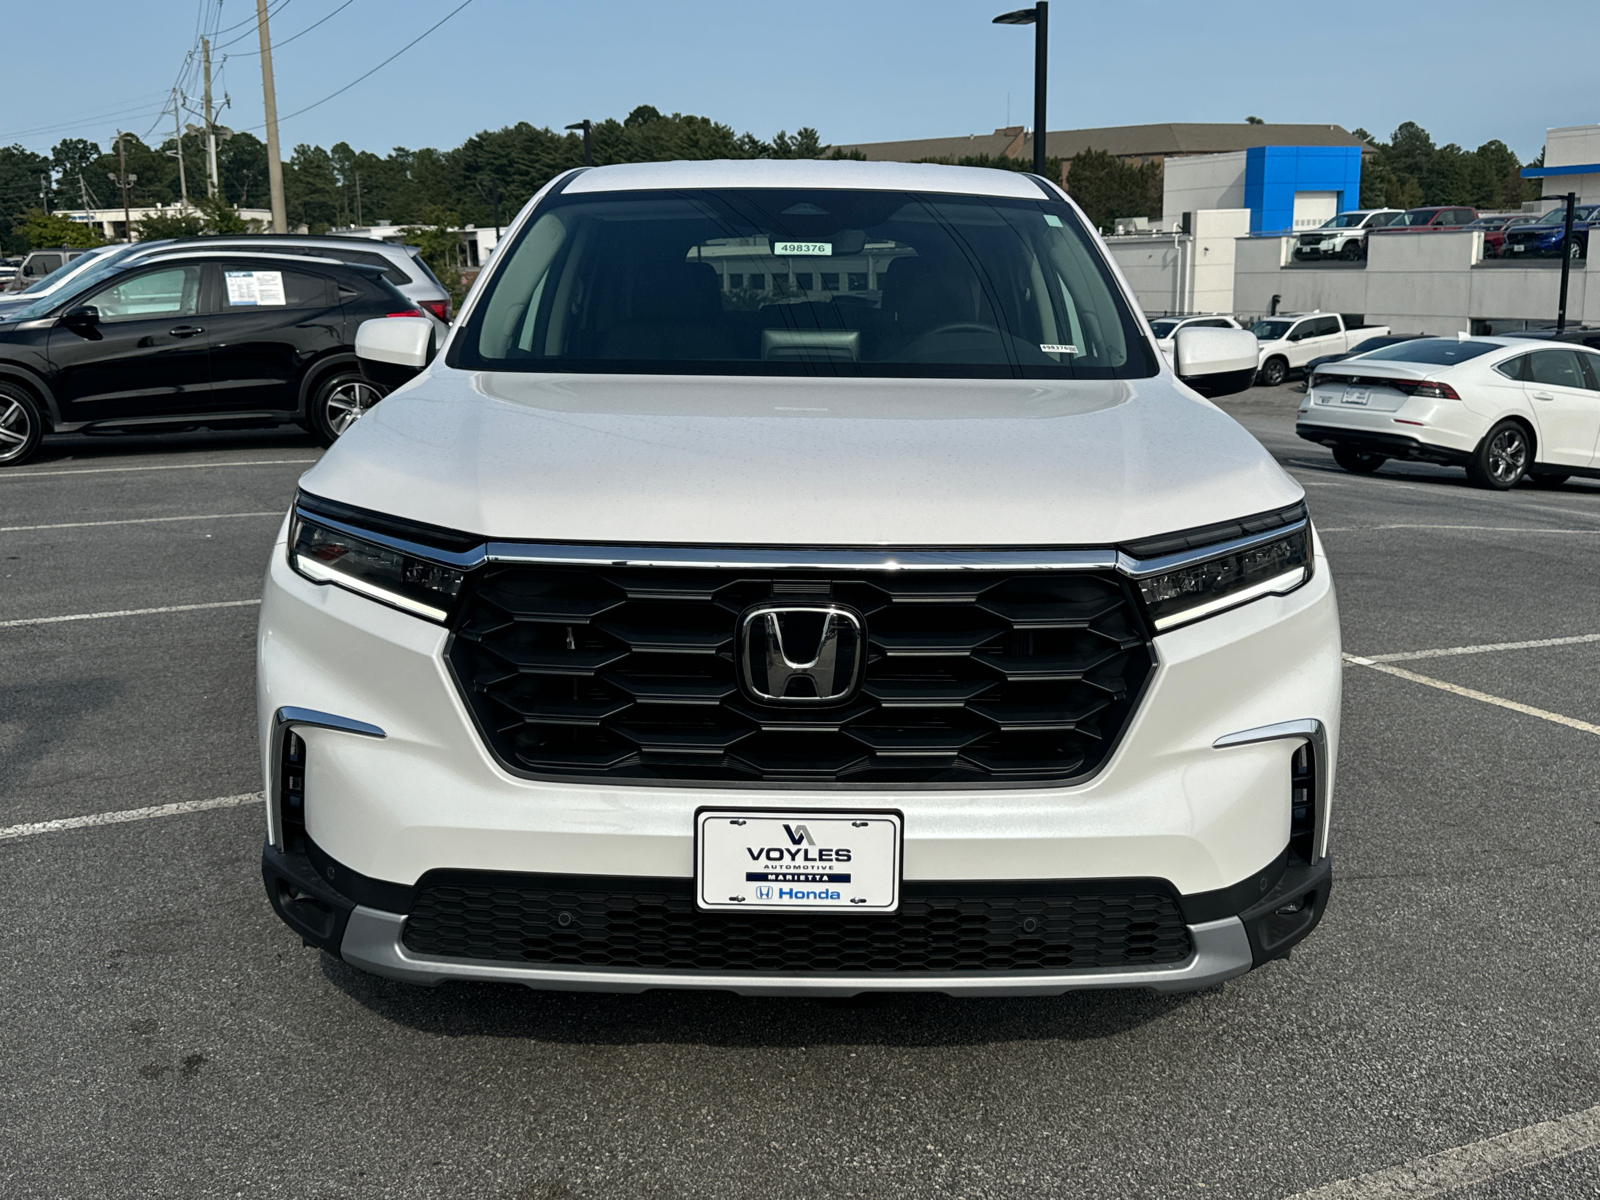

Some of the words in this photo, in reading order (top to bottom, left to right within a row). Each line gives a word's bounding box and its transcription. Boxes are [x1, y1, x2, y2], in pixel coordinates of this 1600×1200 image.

[781, 244, 826, 253] 498376
[746, 847, 852, 862] VOYLES
[778, 887, 841, 900] Honda
